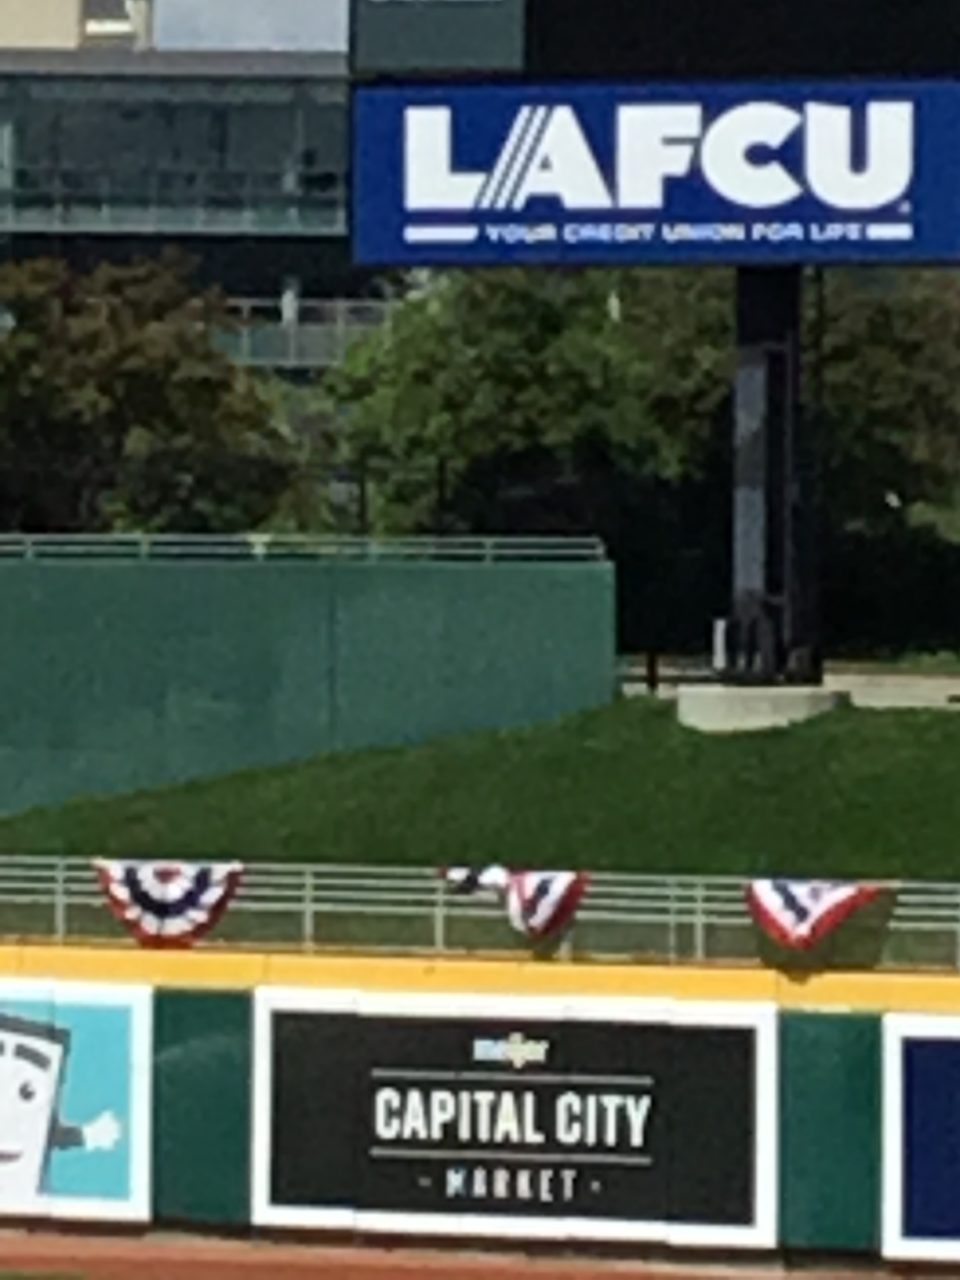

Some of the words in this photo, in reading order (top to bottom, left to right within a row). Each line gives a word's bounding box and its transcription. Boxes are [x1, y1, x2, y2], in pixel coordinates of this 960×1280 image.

[403, 100, 914, 210] LAFCU
[374, 1087, 546, 1144] CAPITAL
[555, 1092, 652, 1147] CITY
[445, 1168, 578, 1202] MARKET
